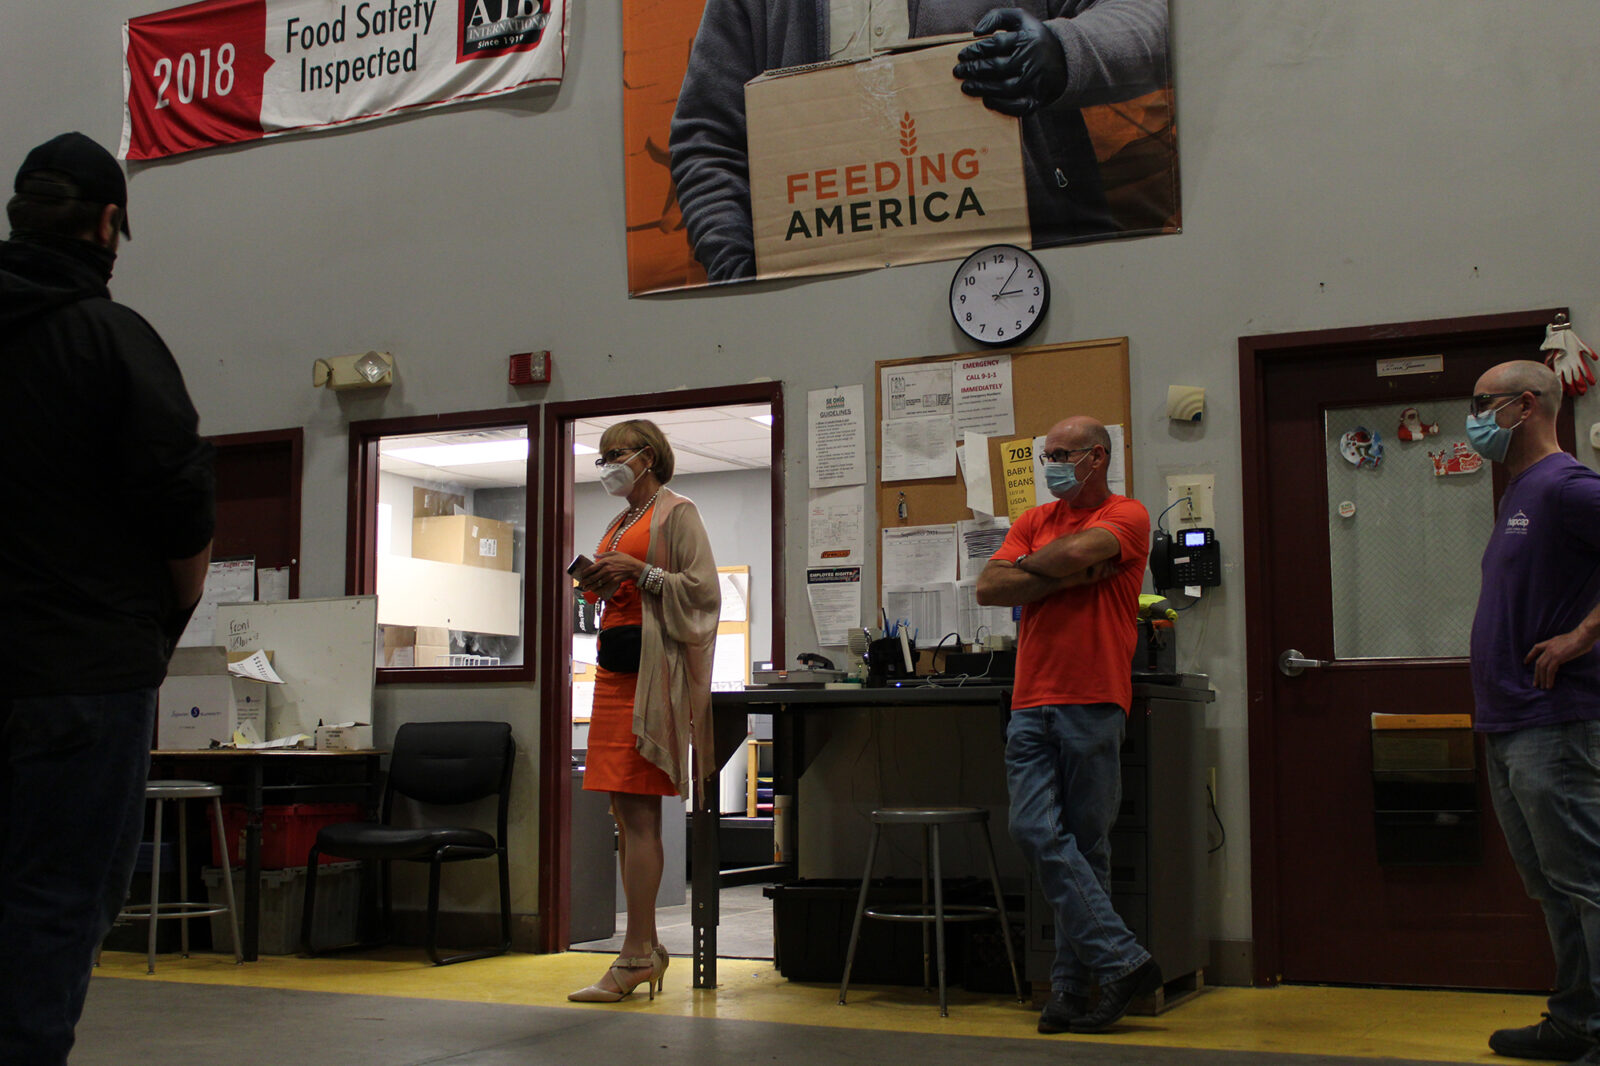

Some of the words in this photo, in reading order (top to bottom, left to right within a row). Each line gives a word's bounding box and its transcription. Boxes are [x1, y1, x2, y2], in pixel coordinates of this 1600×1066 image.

[286, 4, 347, 53] Food
[355, 0, 437, 39] Safety
[300, 33, 418, 94] Inspected
[153, 42, 235, 110] 2018
[786, 148, 980, 204] FEEDING
[785, 186, 986, 241] AMERICA
[992, 254, 1005, 264] 12
[977, 261, 987, 271] 11
[1026, 268, 1034, 279] 2
[964, 275, 976, 287] 10
[1033, 286, 1040, 296] 3
[959, 294, 967, 304] 9
[1028, 304, 1035, 314] 4
[965, 311, 972, 322] 8
[979, 323, 986, 334] 7
[1015, 320, 1022, 330] 5
[997, 327, 1004, 337] 6
[962, 359, 1000, 370] EMERGENCY
[981, 372, 997, 380] 9-1-1
[960, 383, 1003, 393] IMMEDIATELY
[819, 408, 852, 419] GUIDELINES
[1009, 446, 1032, 460] 703
[1006, 465, 1027, 477] BABY
[1008, 477, 1034, 488] BEANS
[1010, 497, 1027, 505] USDA
